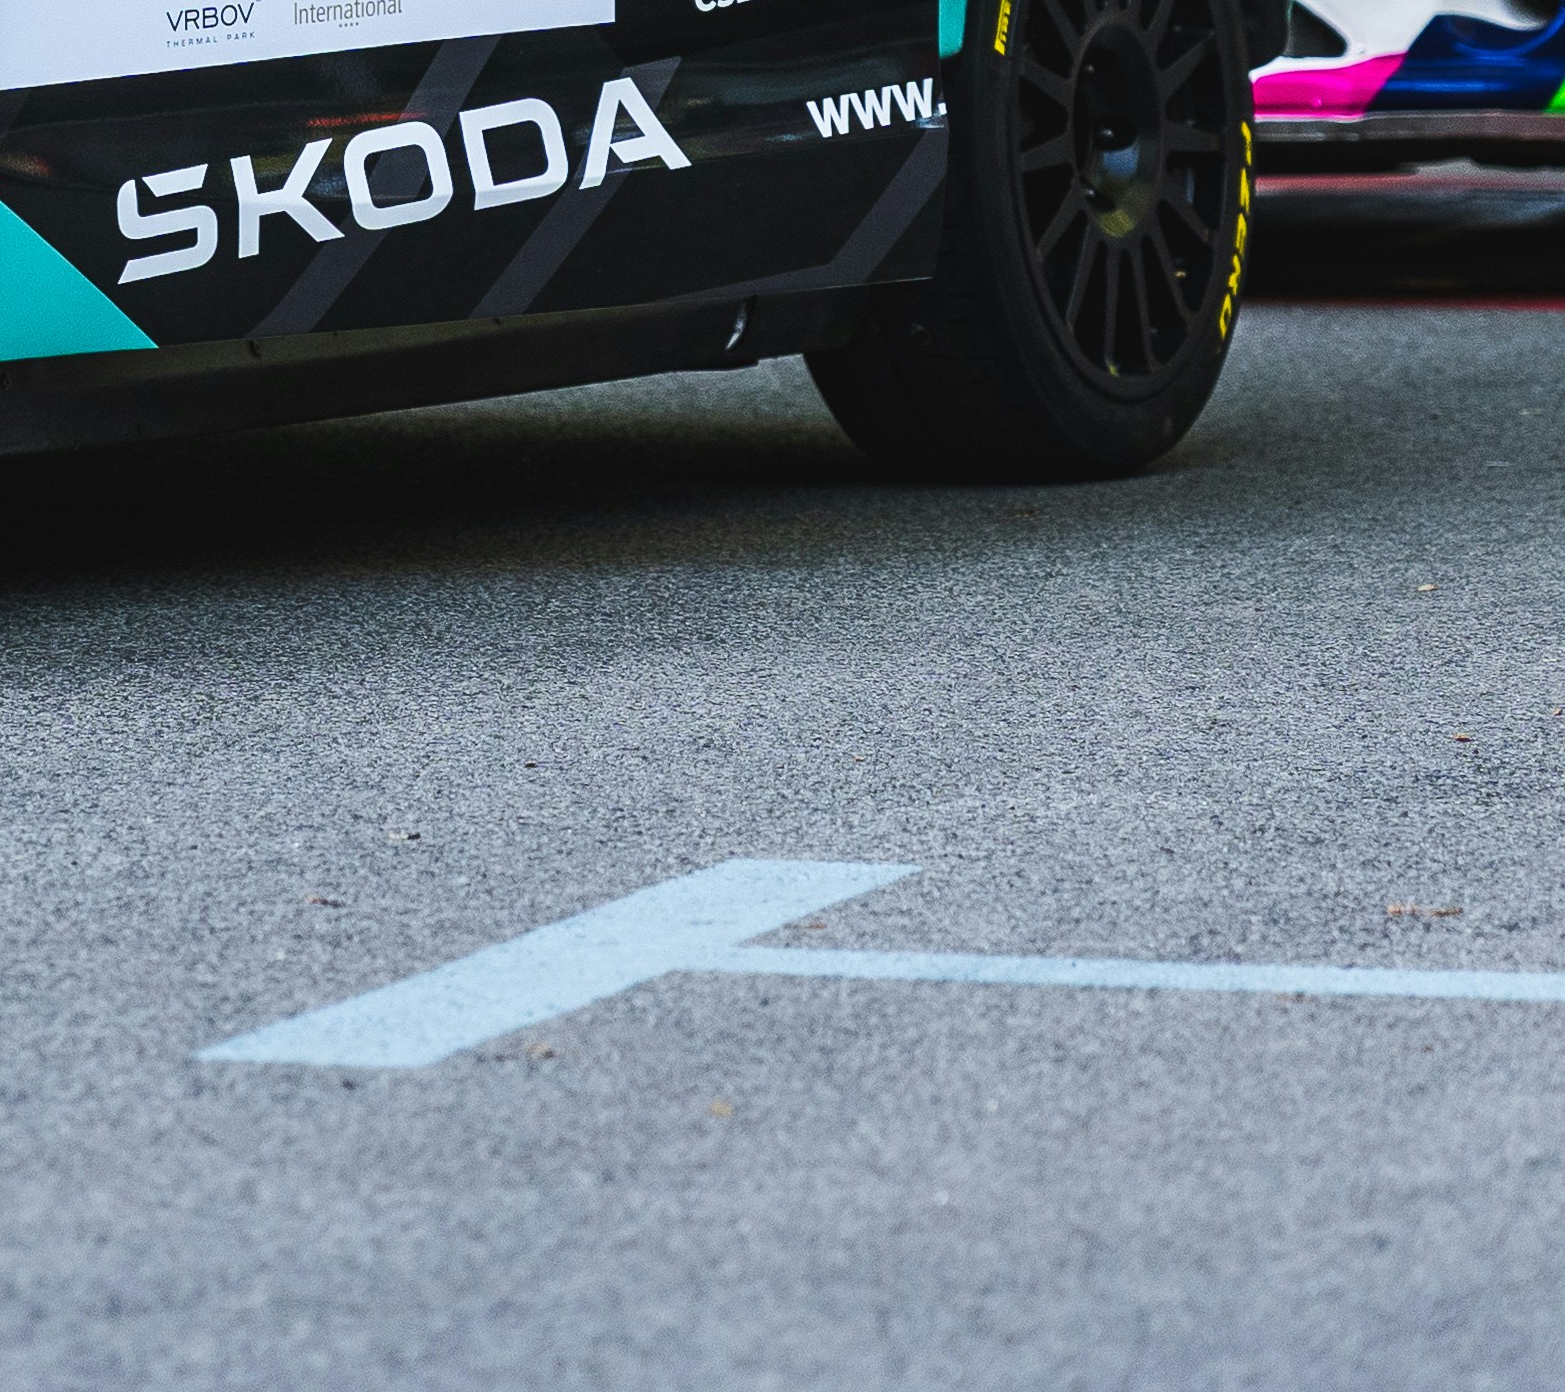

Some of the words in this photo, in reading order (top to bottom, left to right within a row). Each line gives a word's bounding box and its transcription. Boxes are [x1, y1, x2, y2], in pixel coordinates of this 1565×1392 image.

[166, 35, 218, 49] THERMAL
[226, 31, 256, 42] PARK
[806, 78, 948, 138] WWW.
